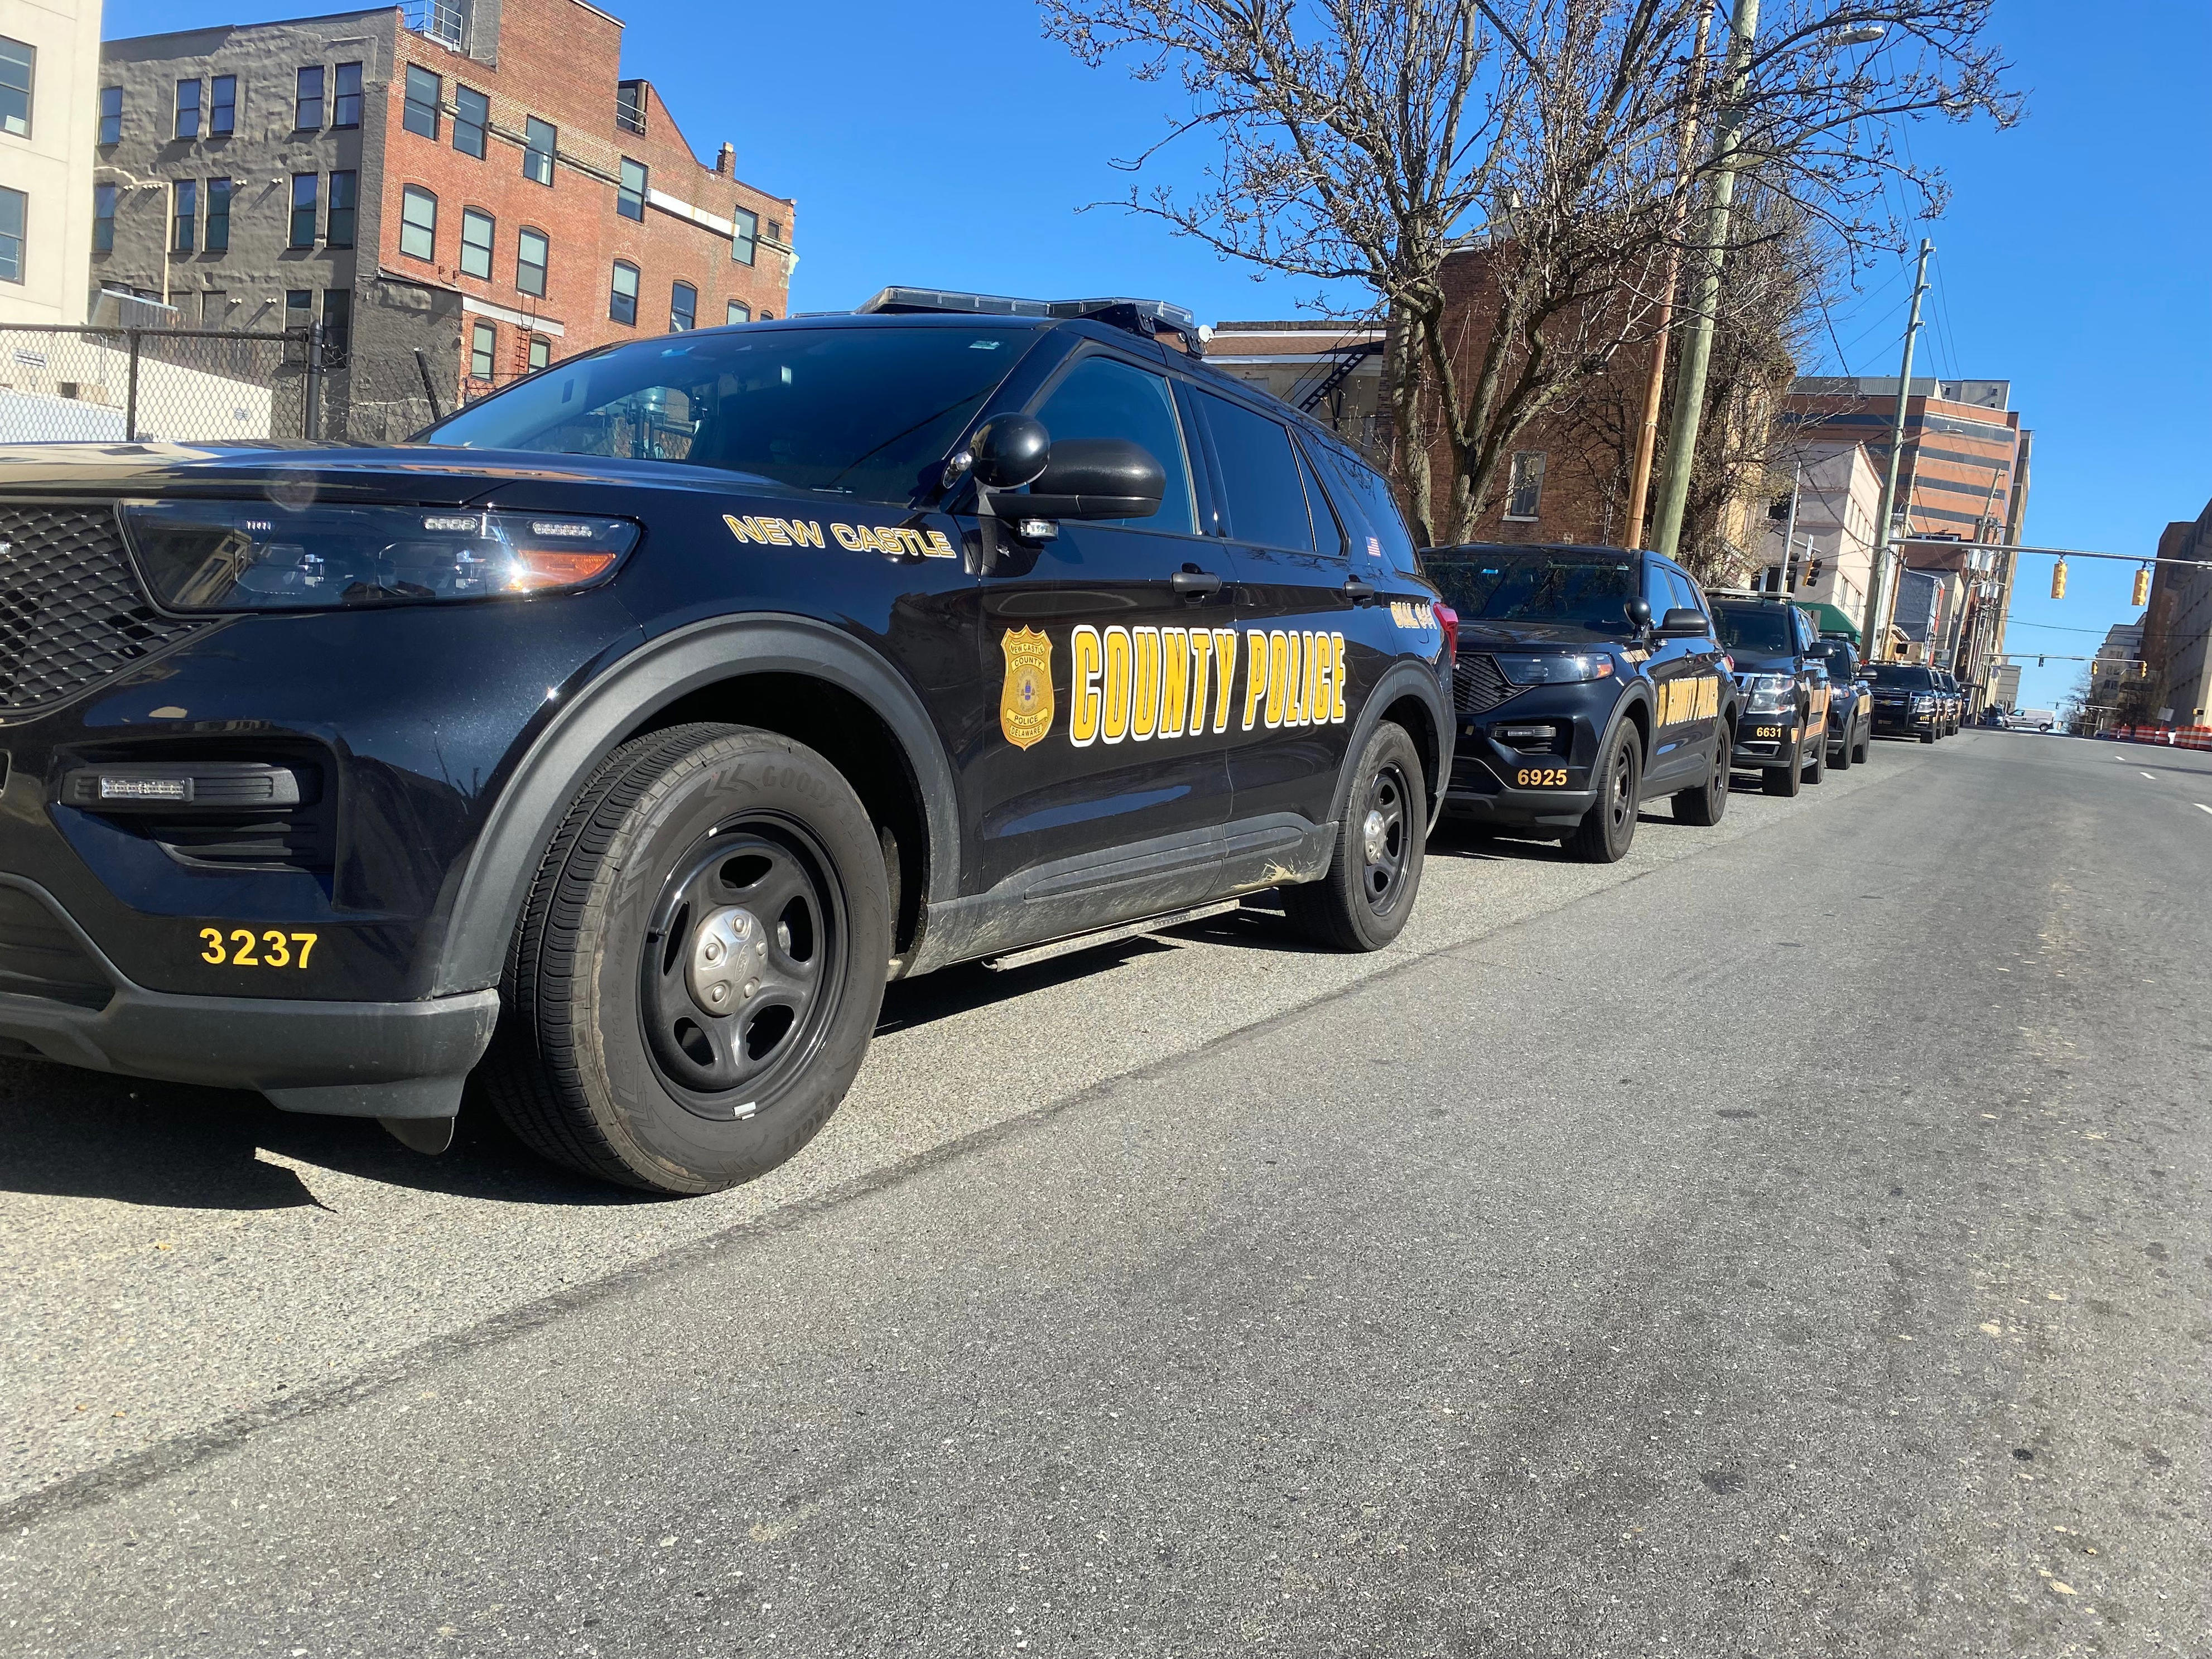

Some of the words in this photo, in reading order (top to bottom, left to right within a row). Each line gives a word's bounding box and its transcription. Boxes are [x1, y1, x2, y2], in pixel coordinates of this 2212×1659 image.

[722, 514, 825, 548] NEW
[830, 523, 956, 558] CASTLE
[1023, 644, 1044, 654] CASTLE
[1014, 656, 1042, 667] COUNTY
[1070, 624, 1237, 747] COUNTY
[1242, 629, 1345, 731] POLICE
[1014, 715, 1038, 725] POLICE
[1011, 726, 1040, 737] DELAWARE
[1756, 727, 1781, 738] 6631
[1517, 769, 1567, 786] 6925
[199, 927, 318, 969] 3237
